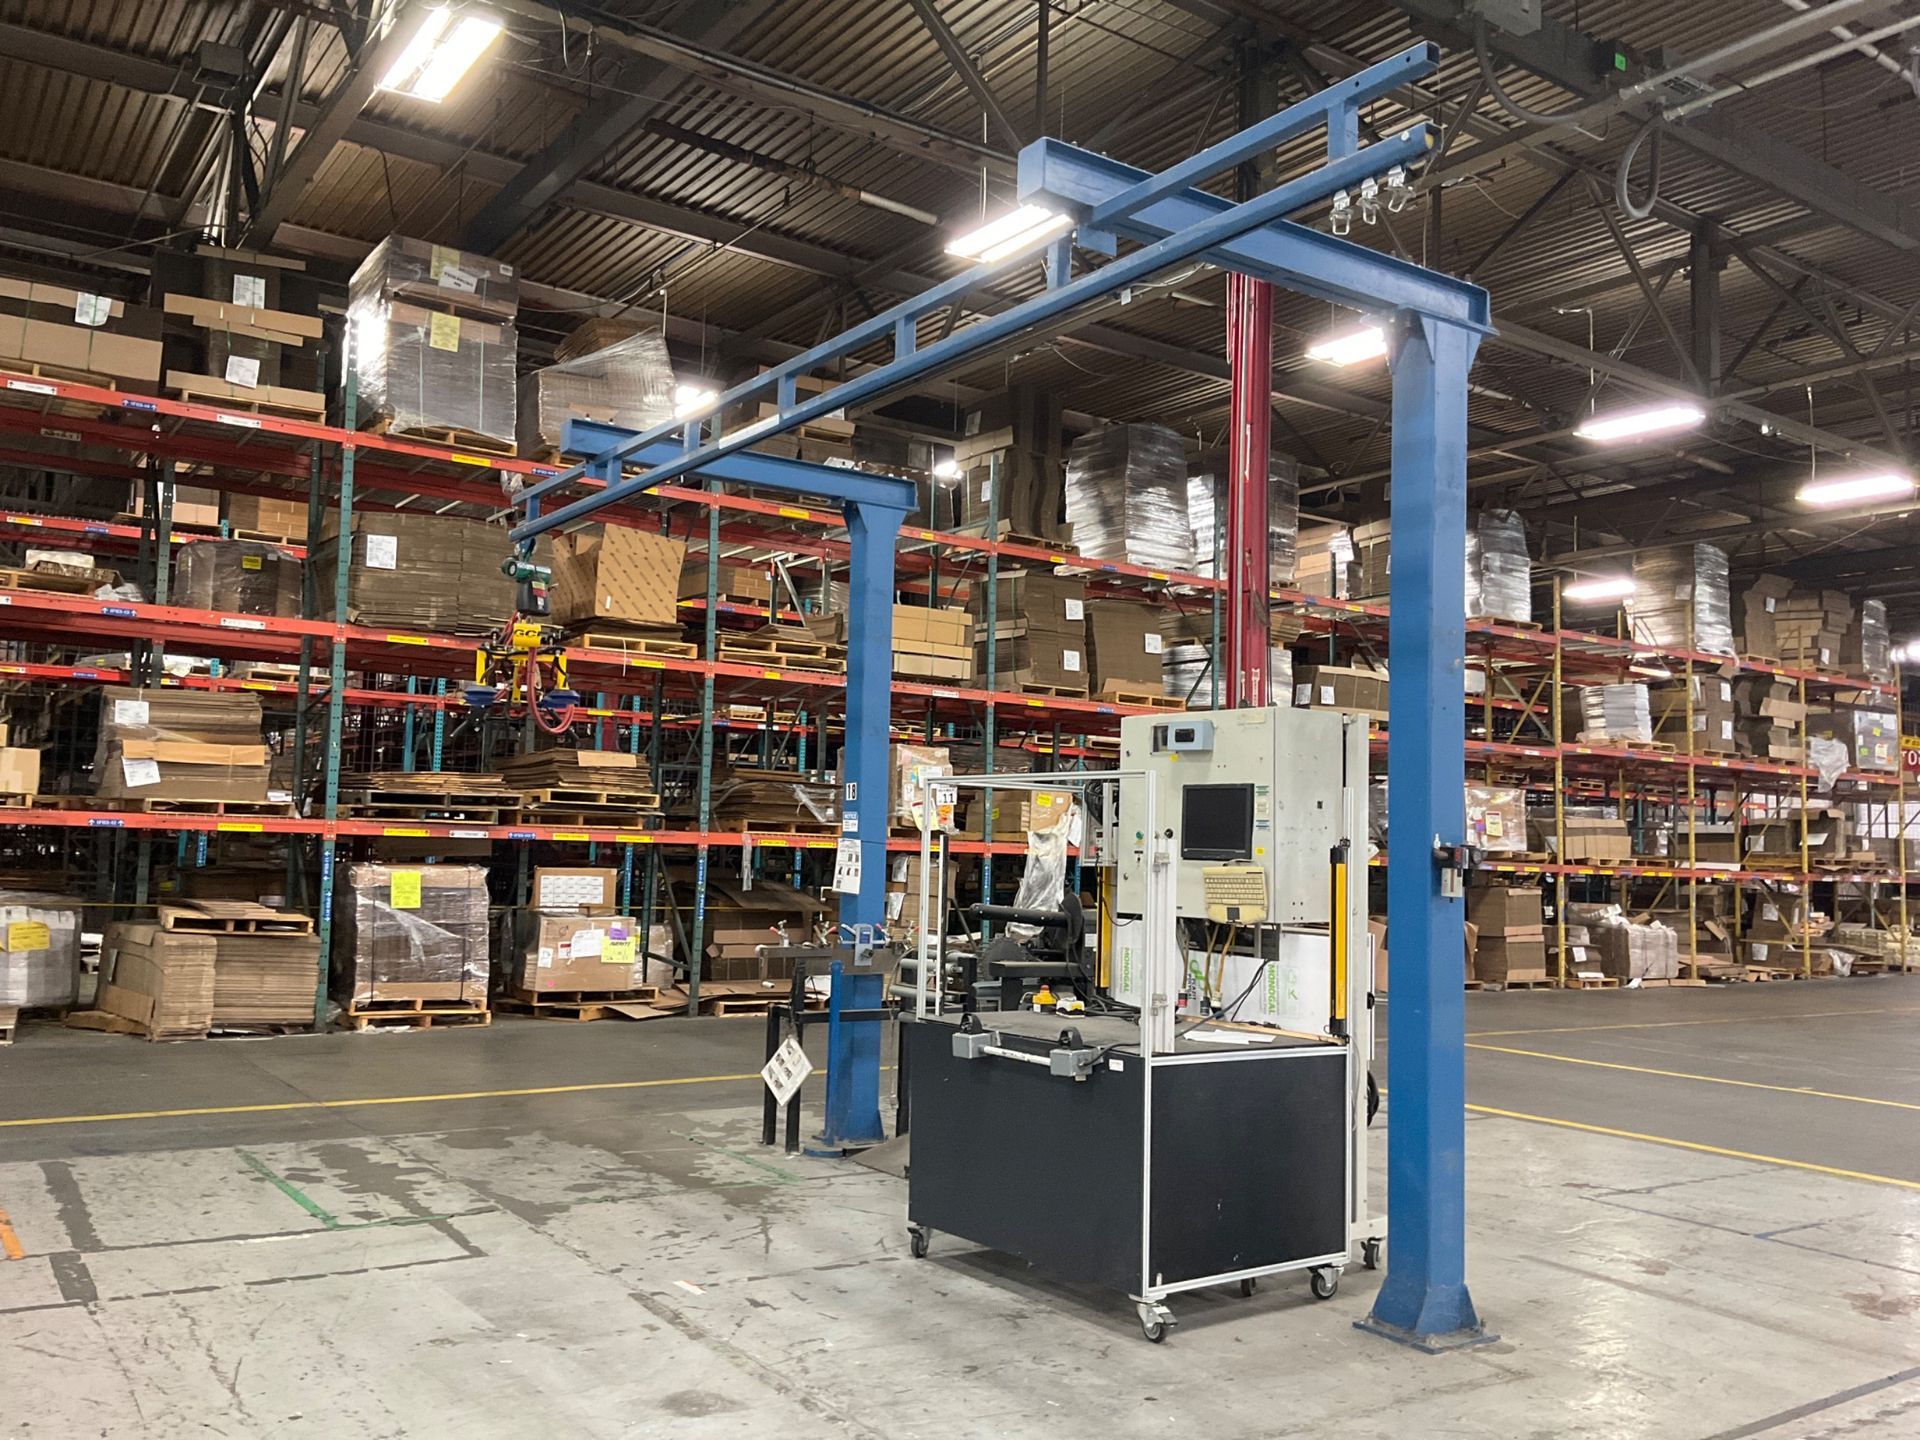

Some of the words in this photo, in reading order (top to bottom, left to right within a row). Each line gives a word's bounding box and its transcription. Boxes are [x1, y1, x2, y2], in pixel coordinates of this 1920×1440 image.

[847, 783, 856, 800] 18
[943, 793, 954, 804] 11
[1123, 946, 1131, 992] MONOGAL
[1267, 963, 1276, 1014] MONOGAL
